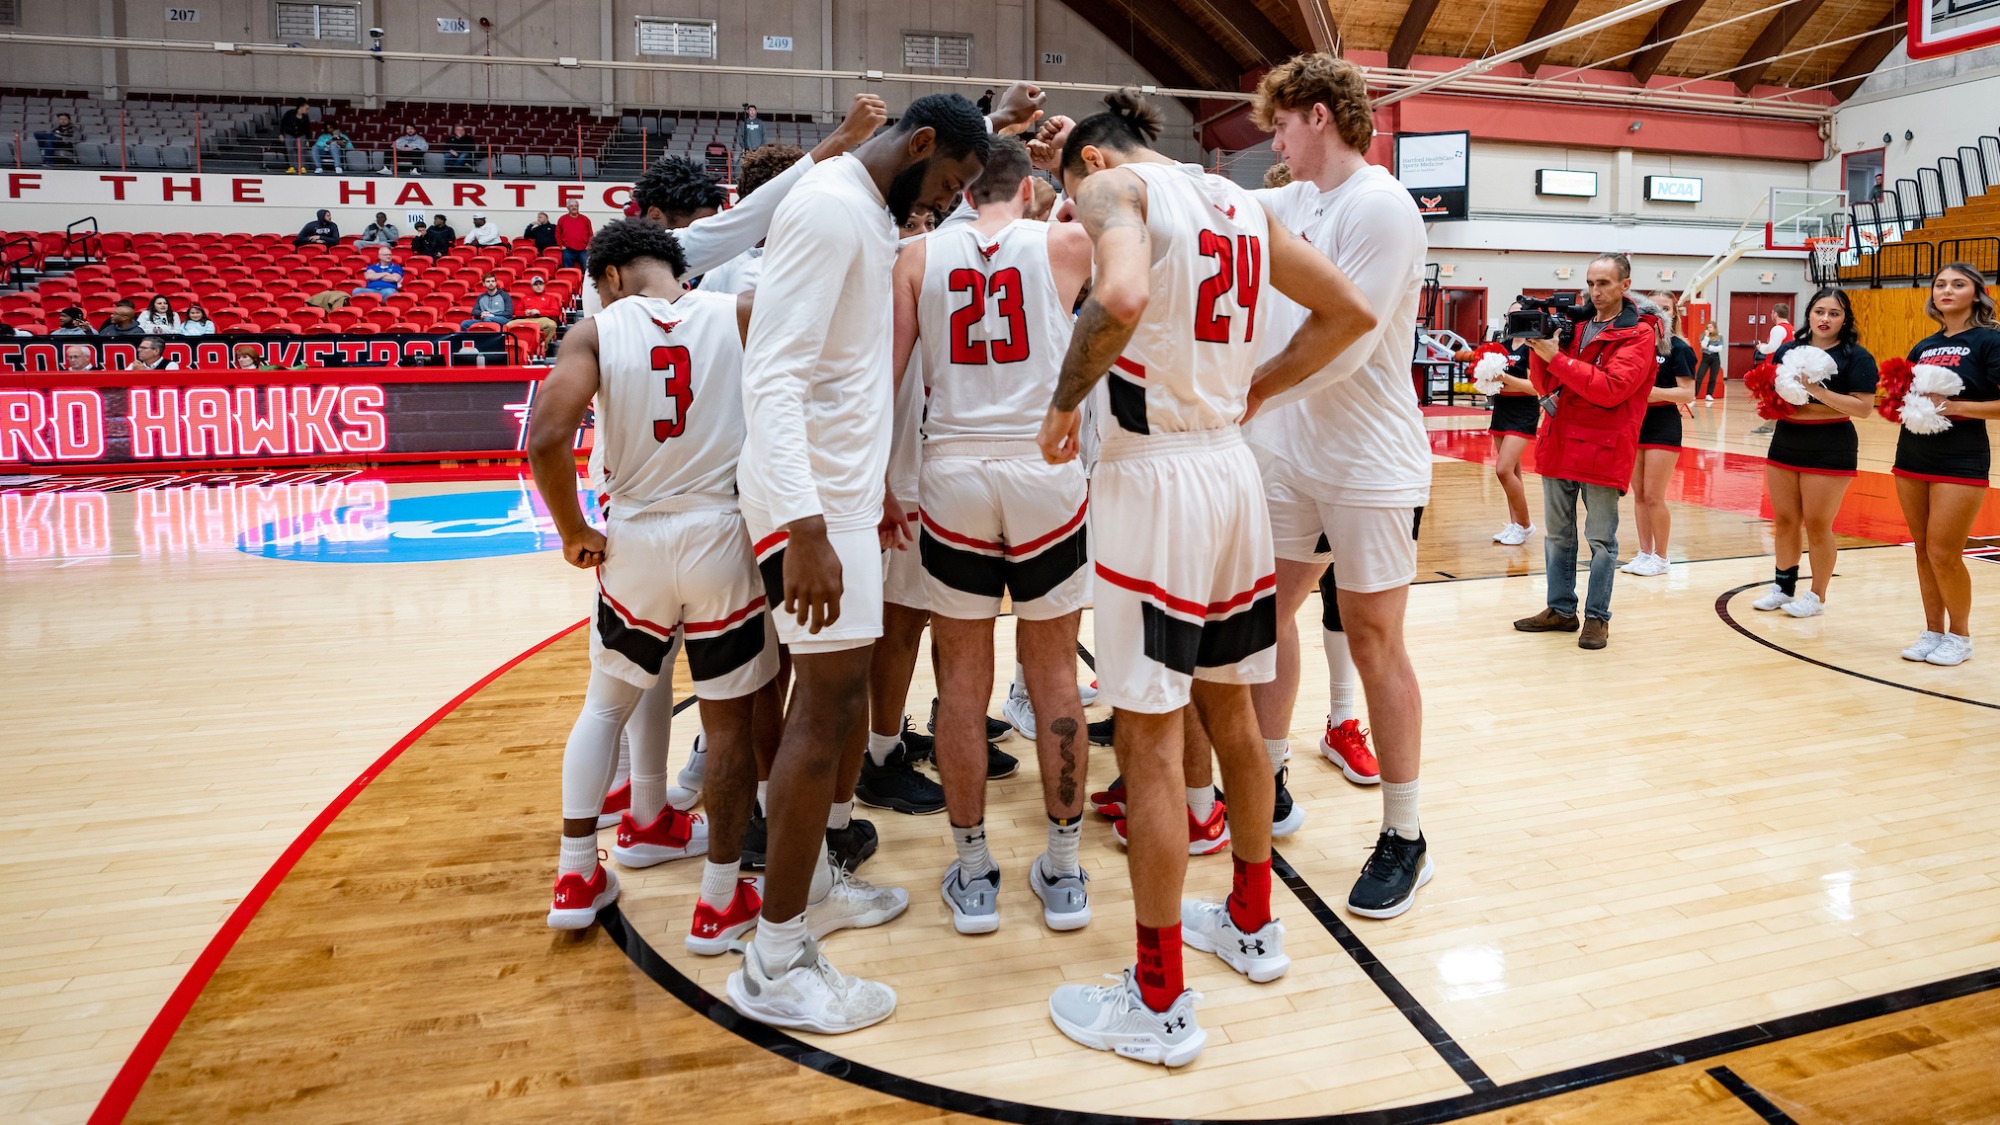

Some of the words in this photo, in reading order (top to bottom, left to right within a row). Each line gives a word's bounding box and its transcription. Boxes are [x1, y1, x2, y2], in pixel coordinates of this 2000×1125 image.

[170, 9, 195, 21] 207
[442, 20, 466, 32] 208
[767, 38, 789, 49] 209
[1045, 54, 1063, 65] 210
[9, 173, 42, 198] F
[100, 175, 268, 203] THE
[1657, 182, 1694, 196] NCAA
[408, 214, 424, 223] 108
[1195, 228, 1261, 344] 24
[949, 267, 1030, 365] 23
[1919, 346, 1971, 359] HARTFORD
[1917, 354, 1961, 367] CHEER
[650, 345, 694, 443] 3
[127, 386, 387, 458] HAWKS
